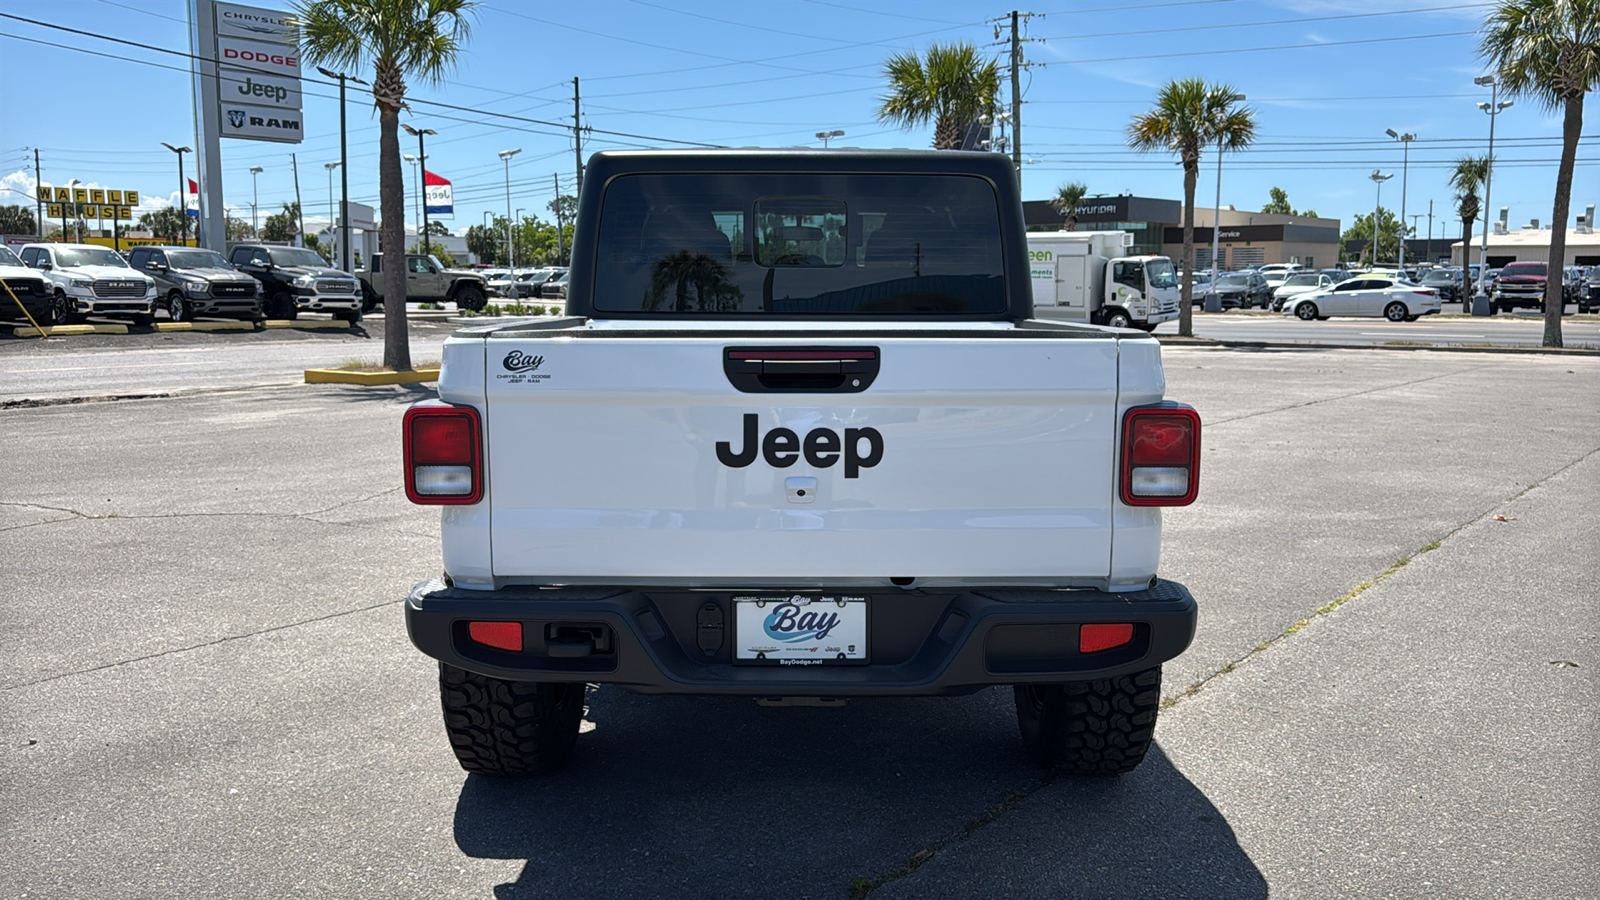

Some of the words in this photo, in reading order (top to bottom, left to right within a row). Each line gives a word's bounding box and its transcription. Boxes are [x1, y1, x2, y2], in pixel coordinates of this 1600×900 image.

[224, 48, 298, 67] DODGE
[238, 78, 287, 102] Jeep
[250, 116, 300, 130] RAM
[40, 188, 136, 203] WAFFLE
[503, 350, 545, 371] Bay
[716, 414, 884, 478] Jeep
[770, 603, 841, 640] Bay
